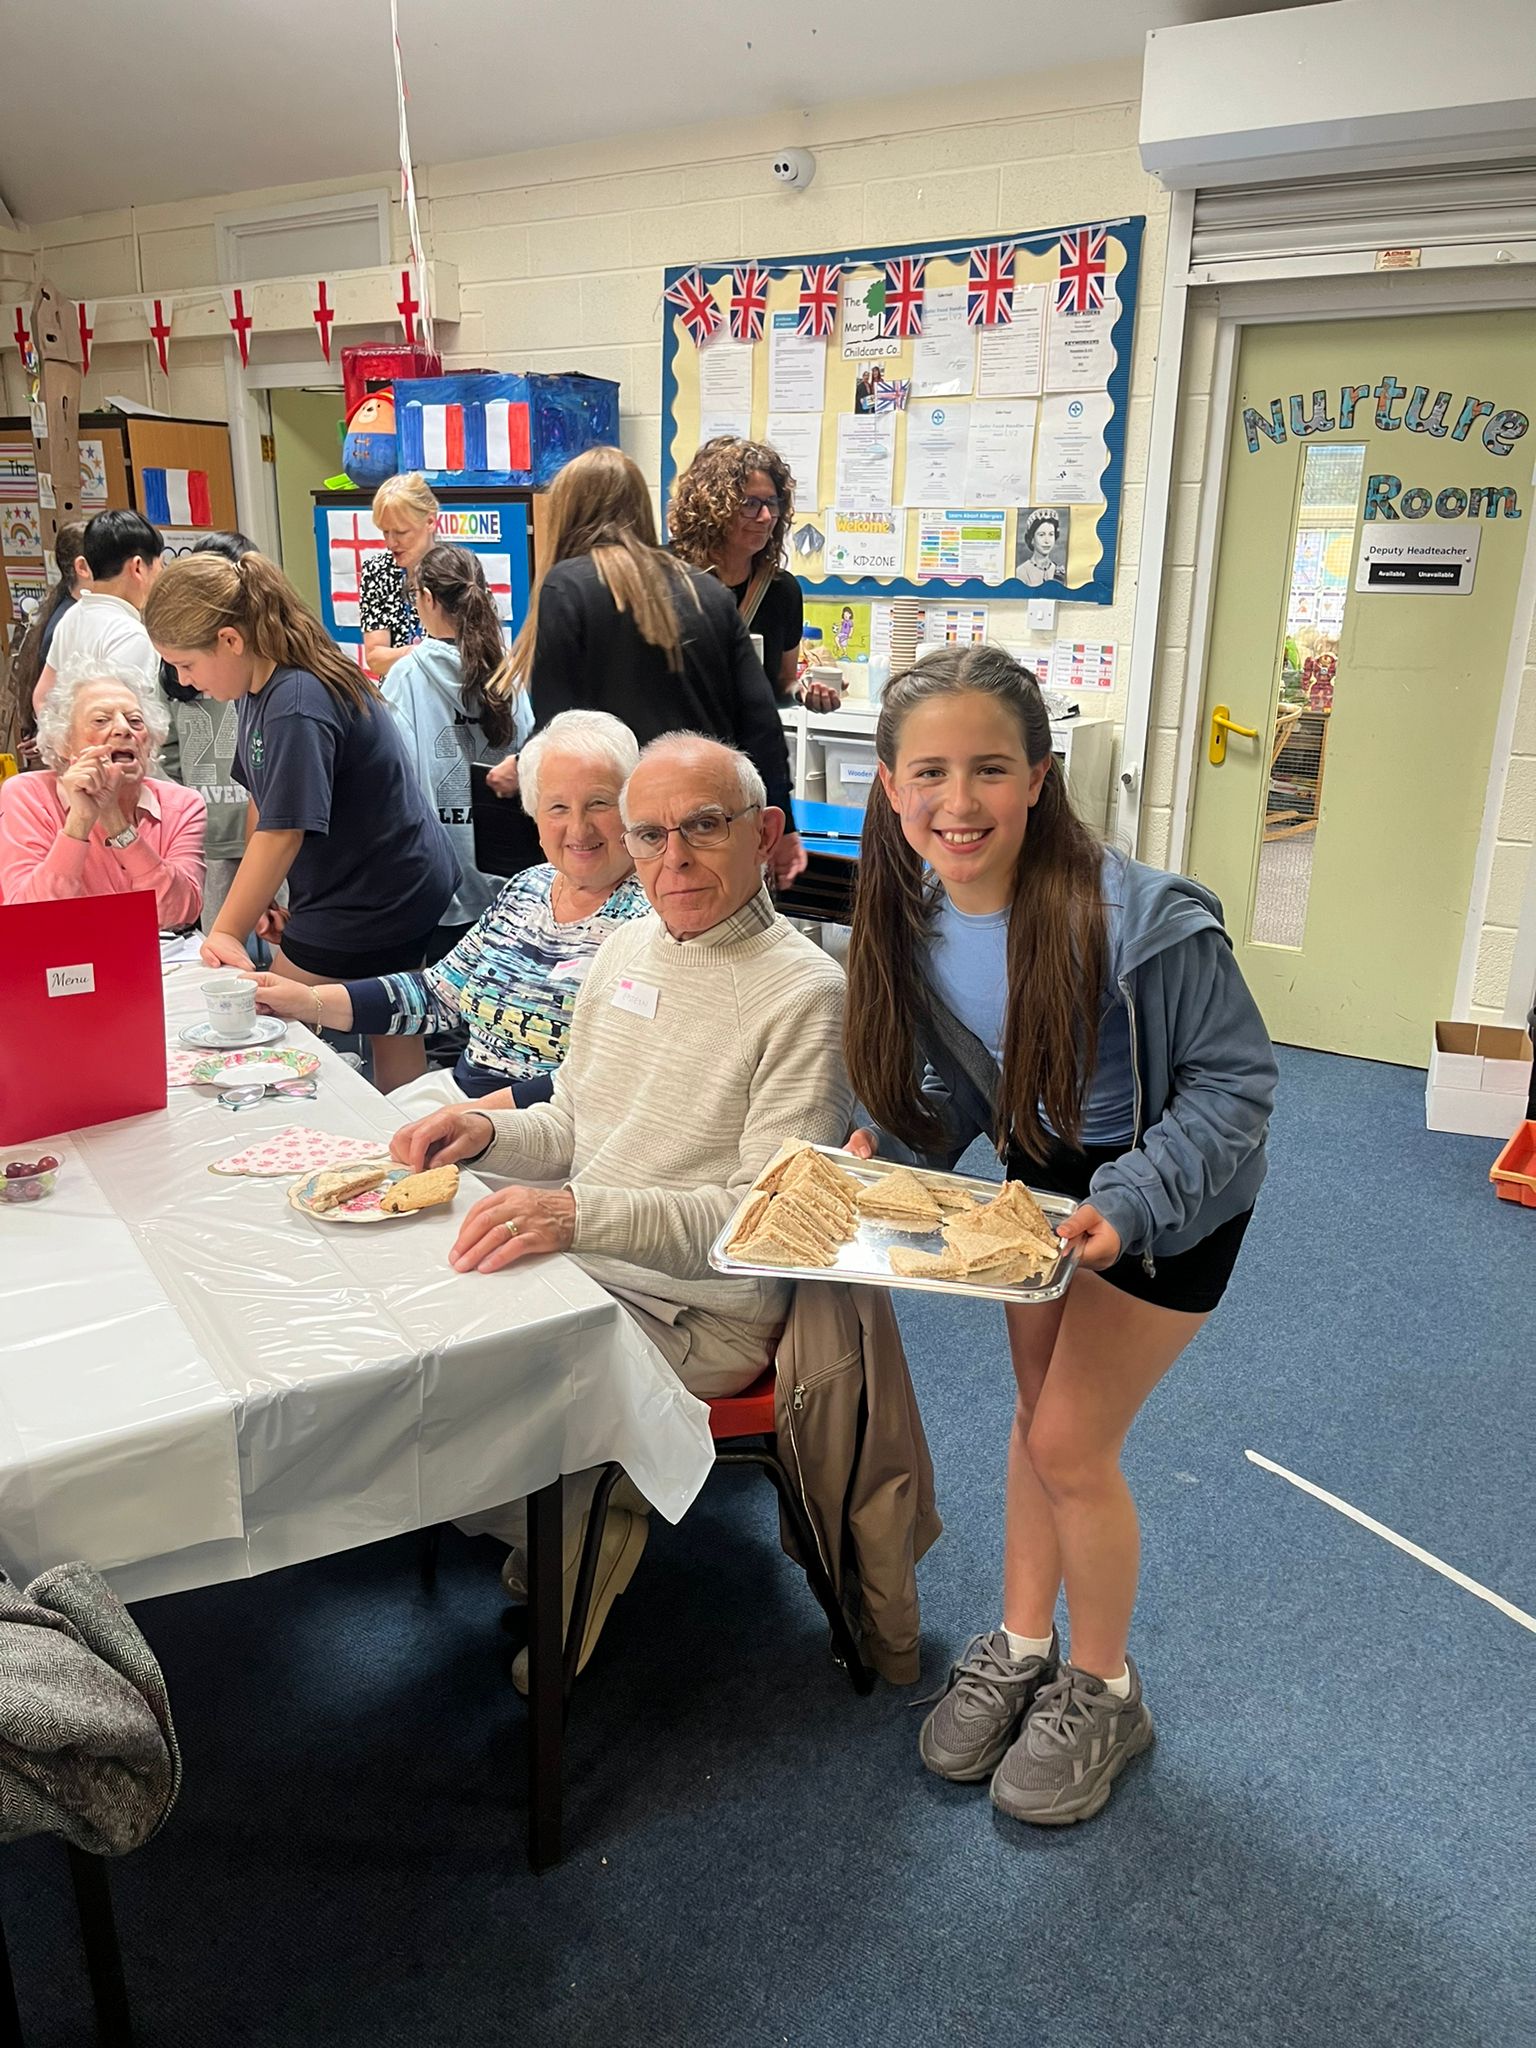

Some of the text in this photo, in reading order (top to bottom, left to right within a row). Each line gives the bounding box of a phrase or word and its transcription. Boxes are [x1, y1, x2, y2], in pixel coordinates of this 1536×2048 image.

[845, 298, 861, 308] The
[844, 321, 875, 334] Marple
[844, 345, 900, 358] Childcare Co.
[1242, 376, 1530, 456] Nurture
[8, 460, 30, 477] The
[1363, 475, 1522, 520] Room
[436, 513, 499, 535] KIDZONE
[835, 517, 891, 535] Welcome
[1369, 546, 1468, 556] Deputy Headteacher
[853, 555, 897, 567] KIDZONE
[1378, 570, 1455, 579] Available Unavailable
[847, 769, 873, 778] Wooden
[51, 971, 90, 989] Menu
